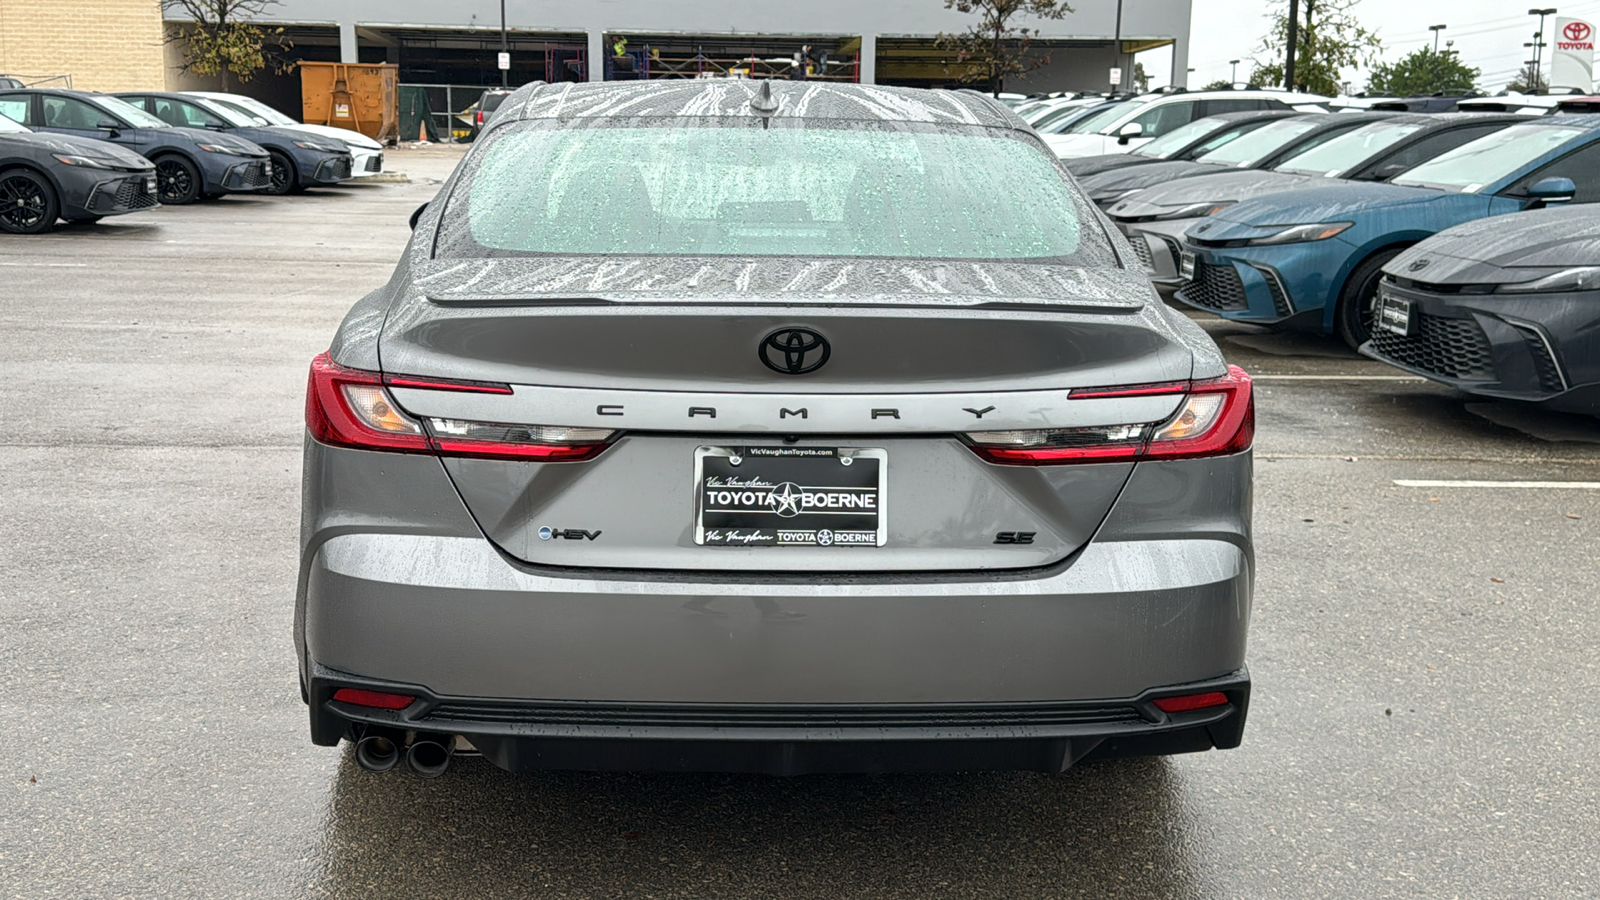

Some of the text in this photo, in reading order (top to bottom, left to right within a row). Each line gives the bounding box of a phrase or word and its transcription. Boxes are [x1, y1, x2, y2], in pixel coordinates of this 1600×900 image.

[1557, 41, 1594, 50] TOYOTA
[596, 404, 996, 419] CAMRY
[750, 448, 833, 457] VicVaughanToyota.com
[706, 476, 773, 489] Vic Vaughan
[706, 491, 776, 506] TOYOTA
[802, 493, 877, 508] BOERNE
[552, 528, 602, 541] HEV
[705, 530, 723, 541] Vic
[726, 530, 774, 543] Vaughan
[777, 532, 817, 542] TOYOTA
[834, 532, 876, 542] BOERNE
[992, 531, 1037, 545] SE
